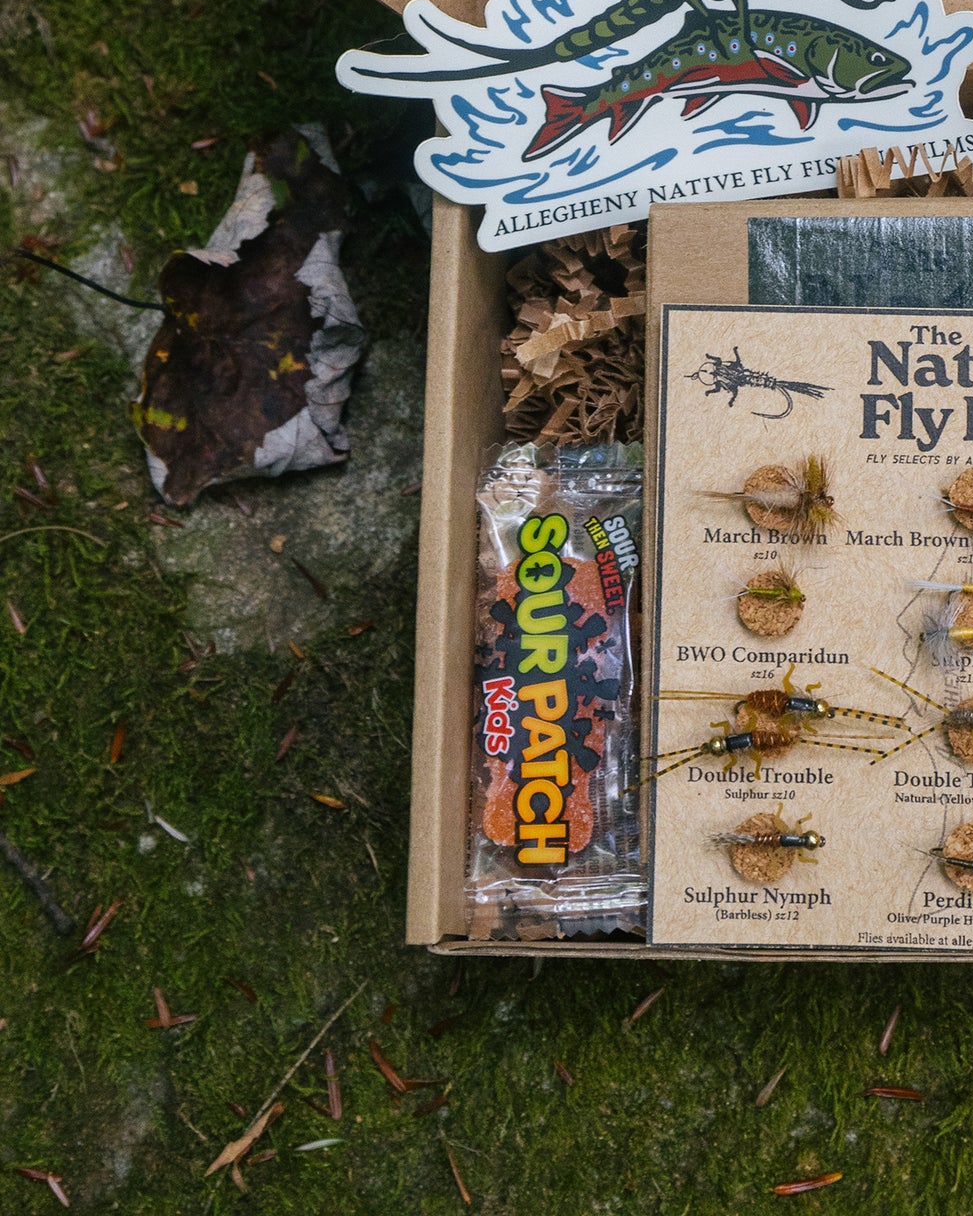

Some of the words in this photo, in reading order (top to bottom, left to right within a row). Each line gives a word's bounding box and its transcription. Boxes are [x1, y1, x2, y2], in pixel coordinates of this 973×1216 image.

[494, 189, 641, 238] ALLEGHENY
[648, 171, 747, 204] NATIVE
[752, 163, 793, 185] FLY
[910, 325, 962, 345] The
[859, 391, 954, 452] Fly
[866, 454, 887, 464] FLY
[893, 455, 940, 465] SELECTS
[946, 456, 960, 465] BY
[585, 517, 610, 550] THEN
[703, 528, 761, 544] March
[845, 530, 903, 547] March
[910, 532, 969, 548] Brown
[604, 516, 639, 571] SOUR
[753, 549, 777, 560] sz10
[516, 515, 569, 674] SOUR
[676, 645, 726, 663] BWO
[732, 646, 849, 668] Comparidun
[751, 669, 775, 679] sz16
[482, 676, 518, 756] Kids
[516, 679, 569, 864] PATCH
[688, 766, 755, 783] Double
[760, 767, 834, 784] Trouble
[894, 771, 961, 788] Double
[725, 788, 769, 800] Sulphur
[772, 790, 796, 800] sz10
[895, 793, 936, 804] Natural
[684, 886, 758, 908] Sulphur
[763, 887, 832, 910] Nymph
[715, 909, 772, 922] (Barbless)
[774, 911, 799, 921] sz12
[887, 912, 960, 927] Olive/Purple
[858, 932, 883, 943] Flies
[887, 933, 935, 945] available
[938, 936, 948, 945] at
